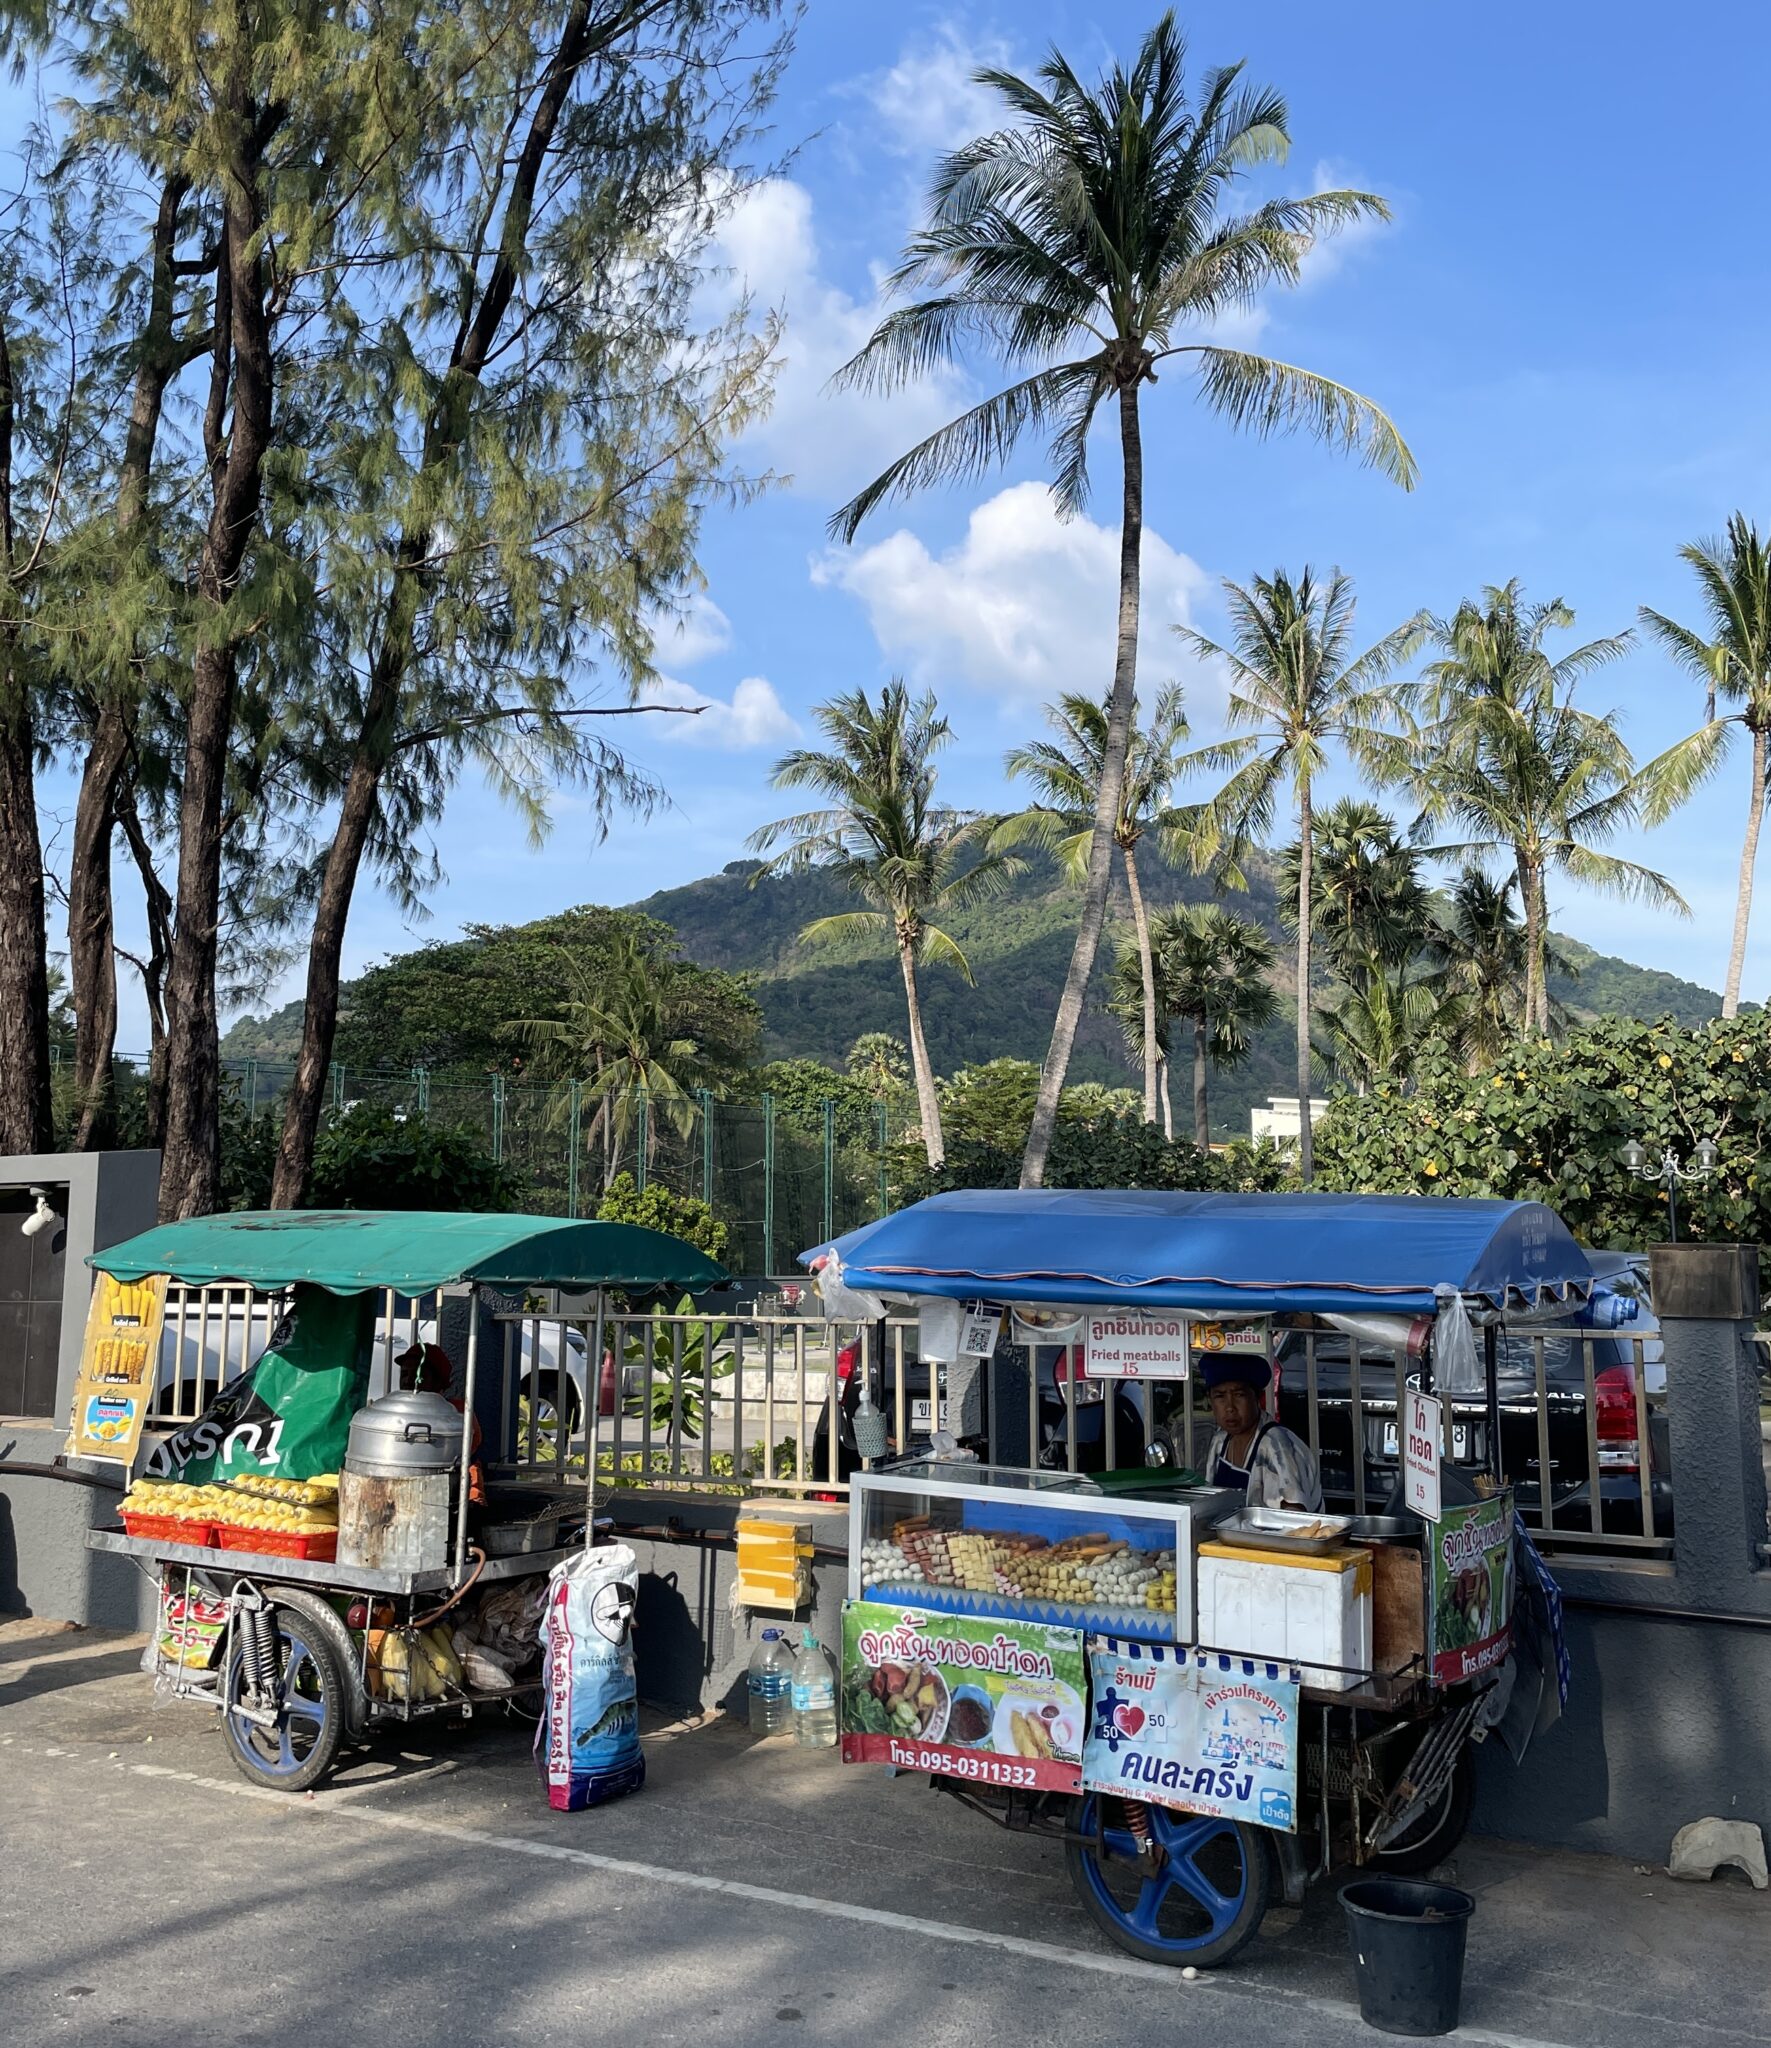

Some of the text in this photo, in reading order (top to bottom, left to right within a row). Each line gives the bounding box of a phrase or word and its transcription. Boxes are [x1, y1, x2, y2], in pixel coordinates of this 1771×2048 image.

[1092, 1316, 1180, 1340] ลูกชินทอด
[1190, 1323, 1226, 1351] 15
[1226, 1328, 1261, 1346] ลูกชิ้น
[1091, 1350, 1181, 1362] Fried meatballs
[1122, 1362, 1139, 1375] 15
[1414, 1397, 1426, 1432] ไก่
[1409, 1433, 1432, 1461] ทอด
[1407, 1456, 1436, 1477] Fried Chicken
[1416, 1483, 1425, 1500] 15
[859, 1614, 1053, 1678] ลูกชิ้นทอดป้าดา
[1115, 1666, 1157, 1693] ร้านนี้
[1204, 1683, 1288, 1723] เข้าร่วมโครงการ
[1103, 1725, 1119, 1739] 50
[1149, 1714, 1165, 1728] 50
[1120, 1752, 1254, 1802] คนละครึ่ง
[1263, 1805, 1289, 1822] เป๋าตัง
